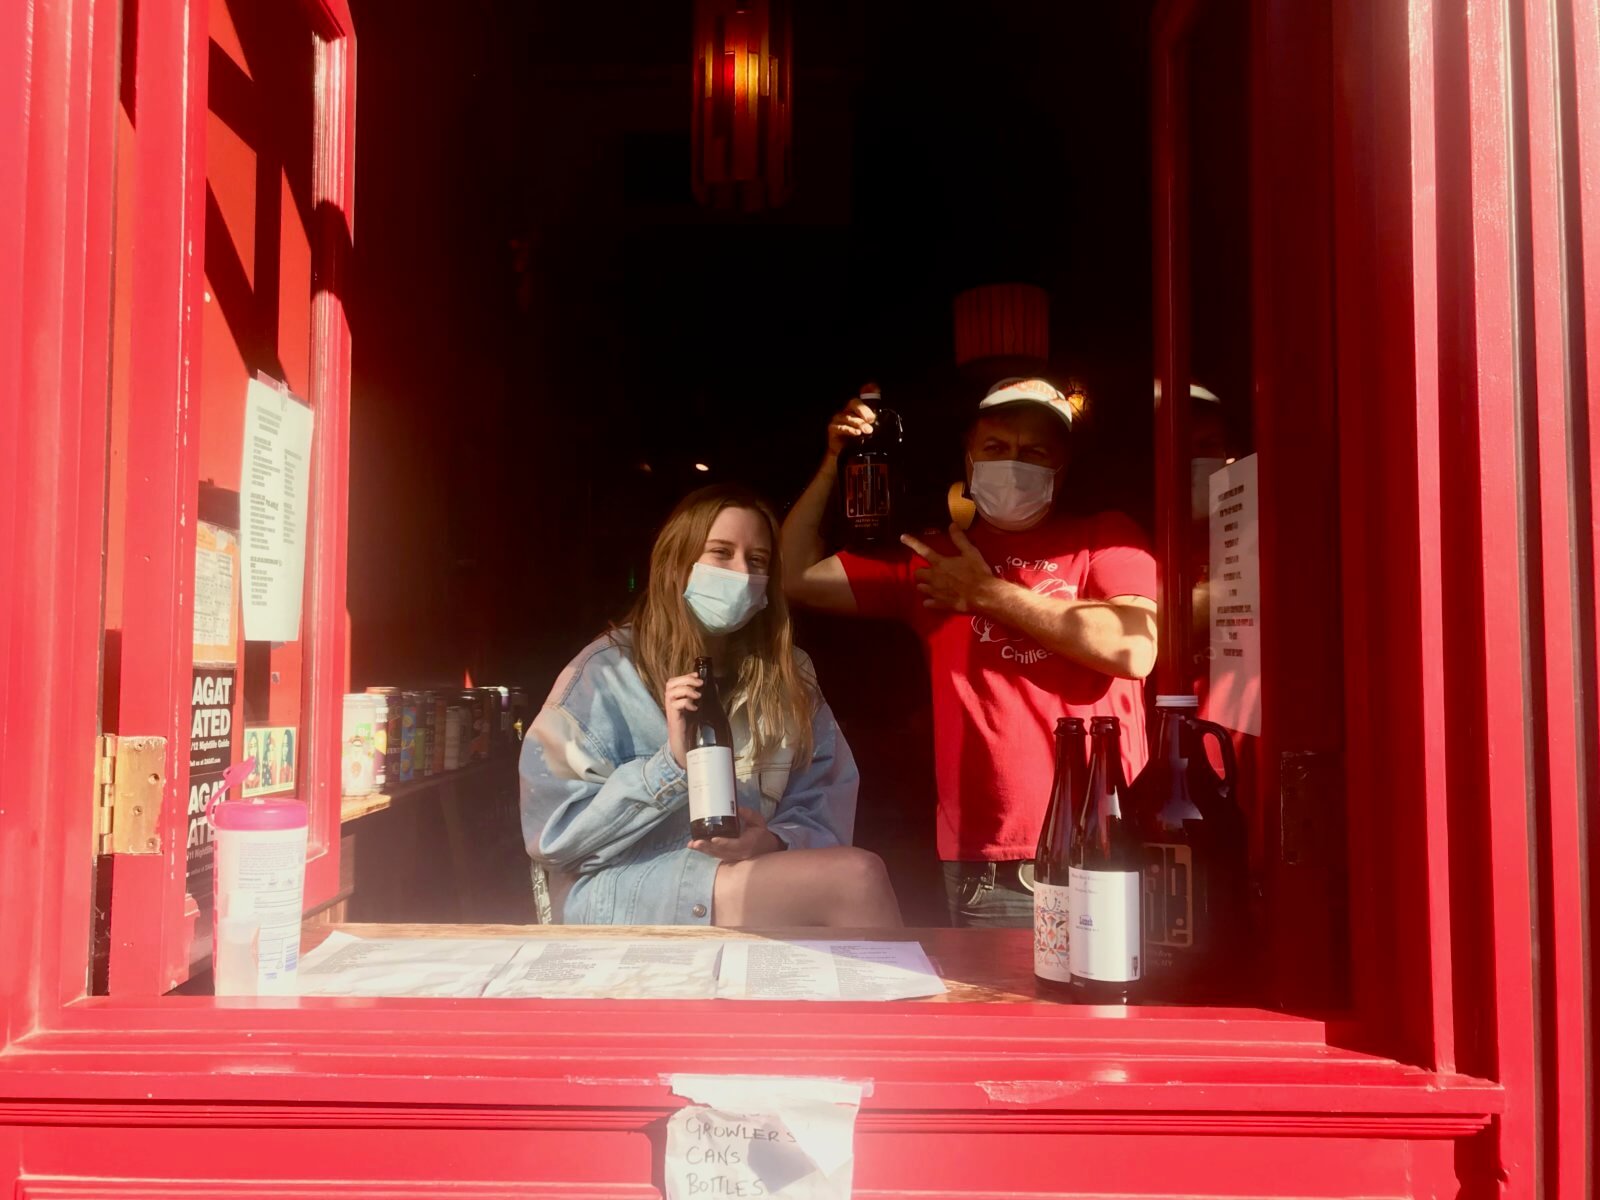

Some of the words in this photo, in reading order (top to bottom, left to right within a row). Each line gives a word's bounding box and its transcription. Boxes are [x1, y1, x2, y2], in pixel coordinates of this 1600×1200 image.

[1033, 559, 1059, 573] The
[1001, 645, 1054, 665] Chilie
[685, 1116, 797, 1143] GROWLERS
[685, 1145, 741, 1165] CANS
[685, 1172, 764, 1197] BOTTLES
